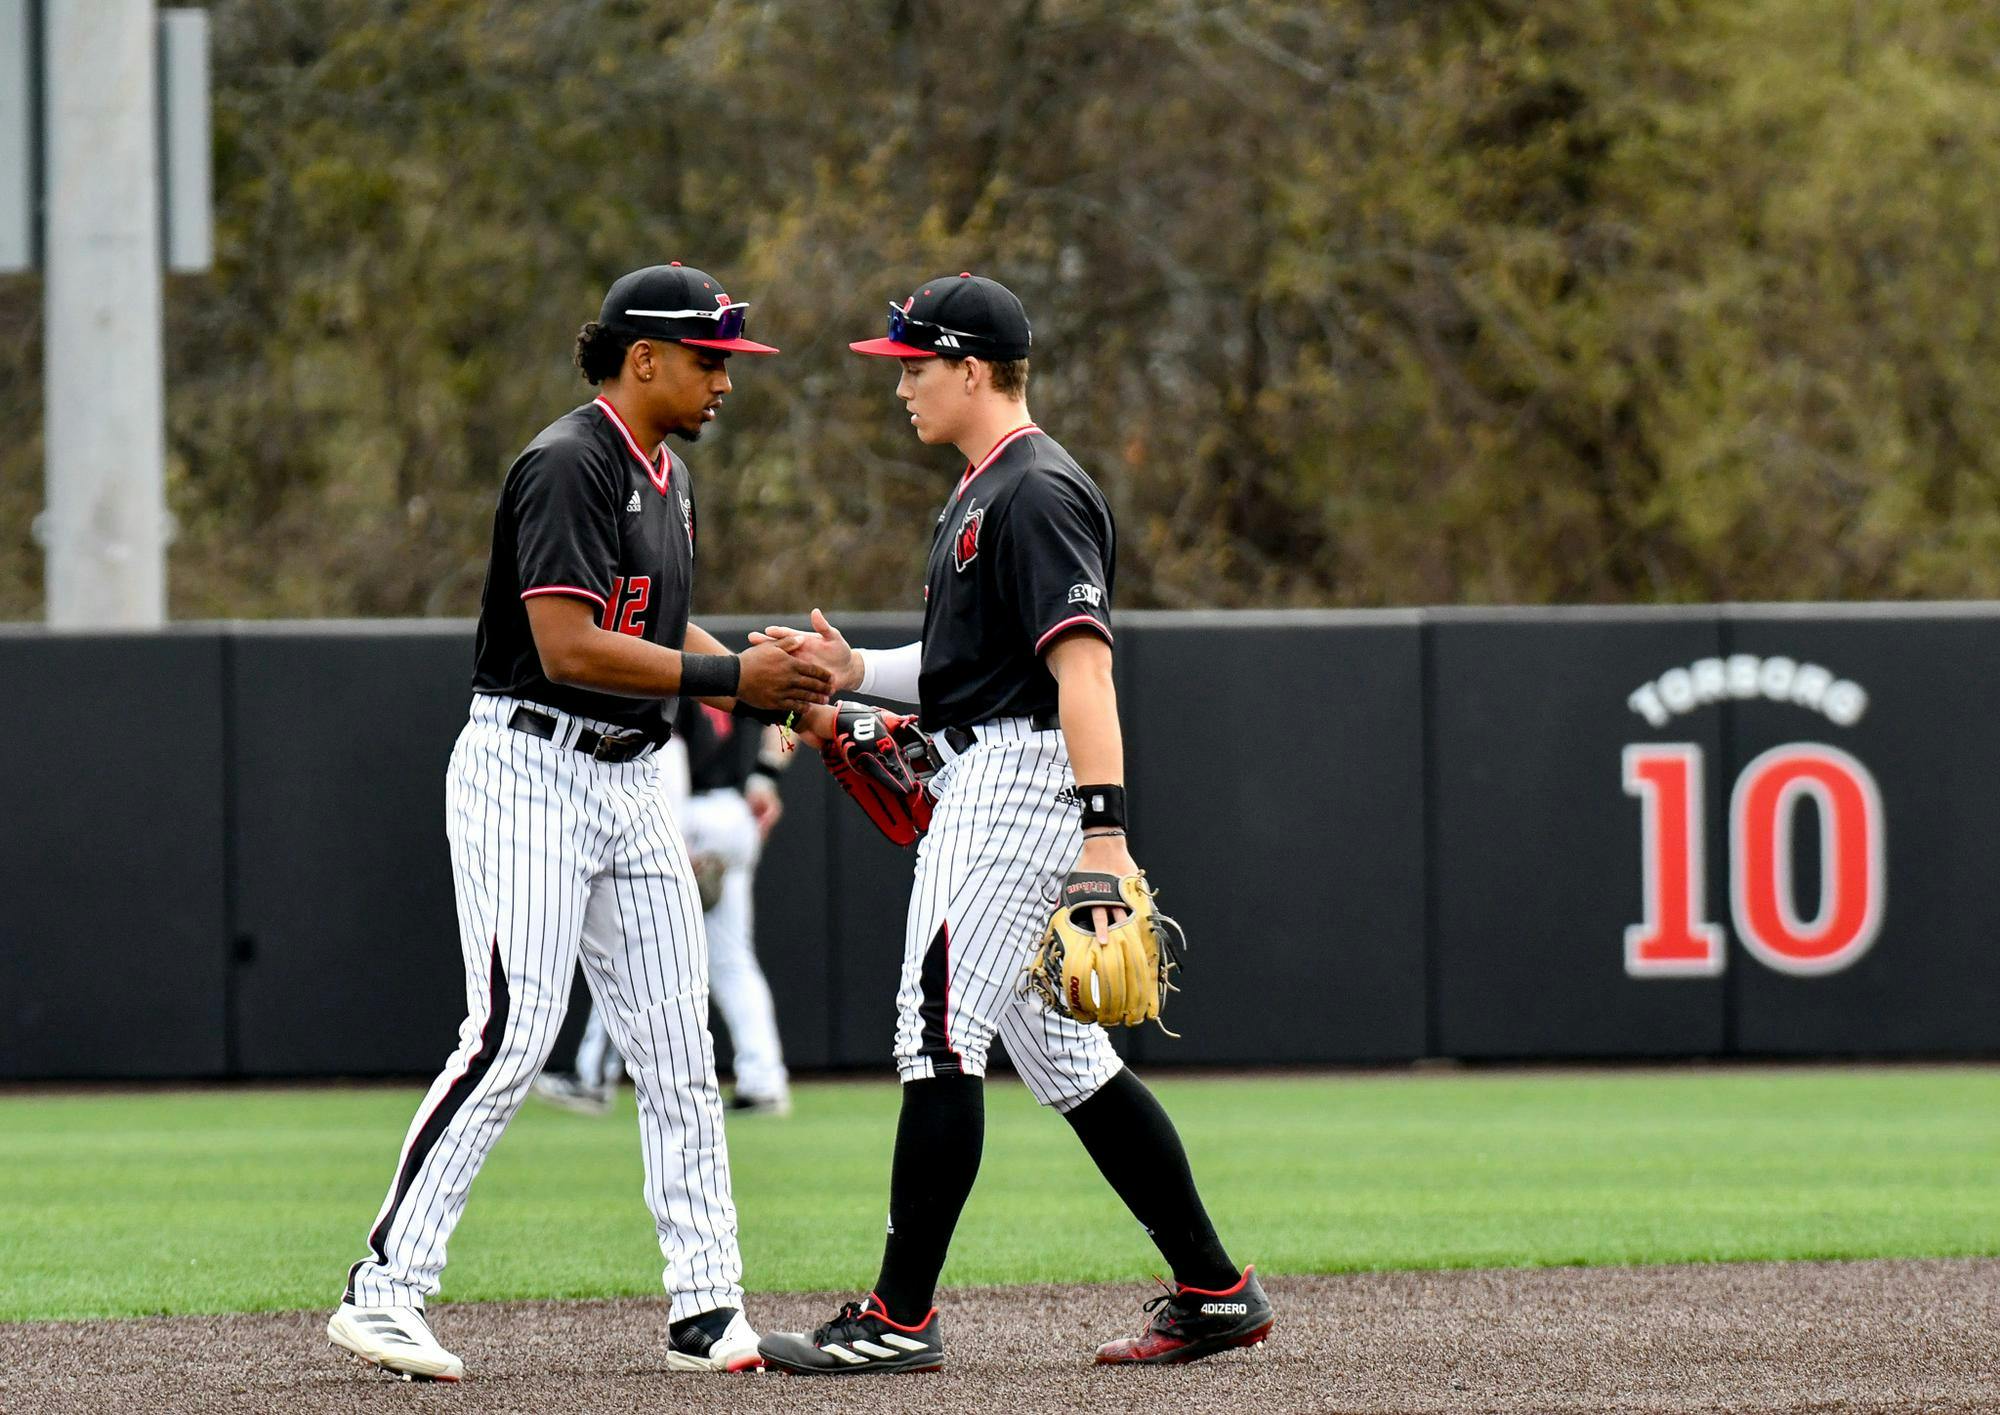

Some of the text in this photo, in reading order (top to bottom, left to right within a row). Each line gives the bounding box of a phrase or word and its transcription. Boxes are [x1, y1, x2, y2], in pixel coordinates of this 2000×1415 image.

[601, 576, 651, 637] 12
[1628, 654, 1868, 727] TORBORG
[1622, 743, 1887, 978] 10
